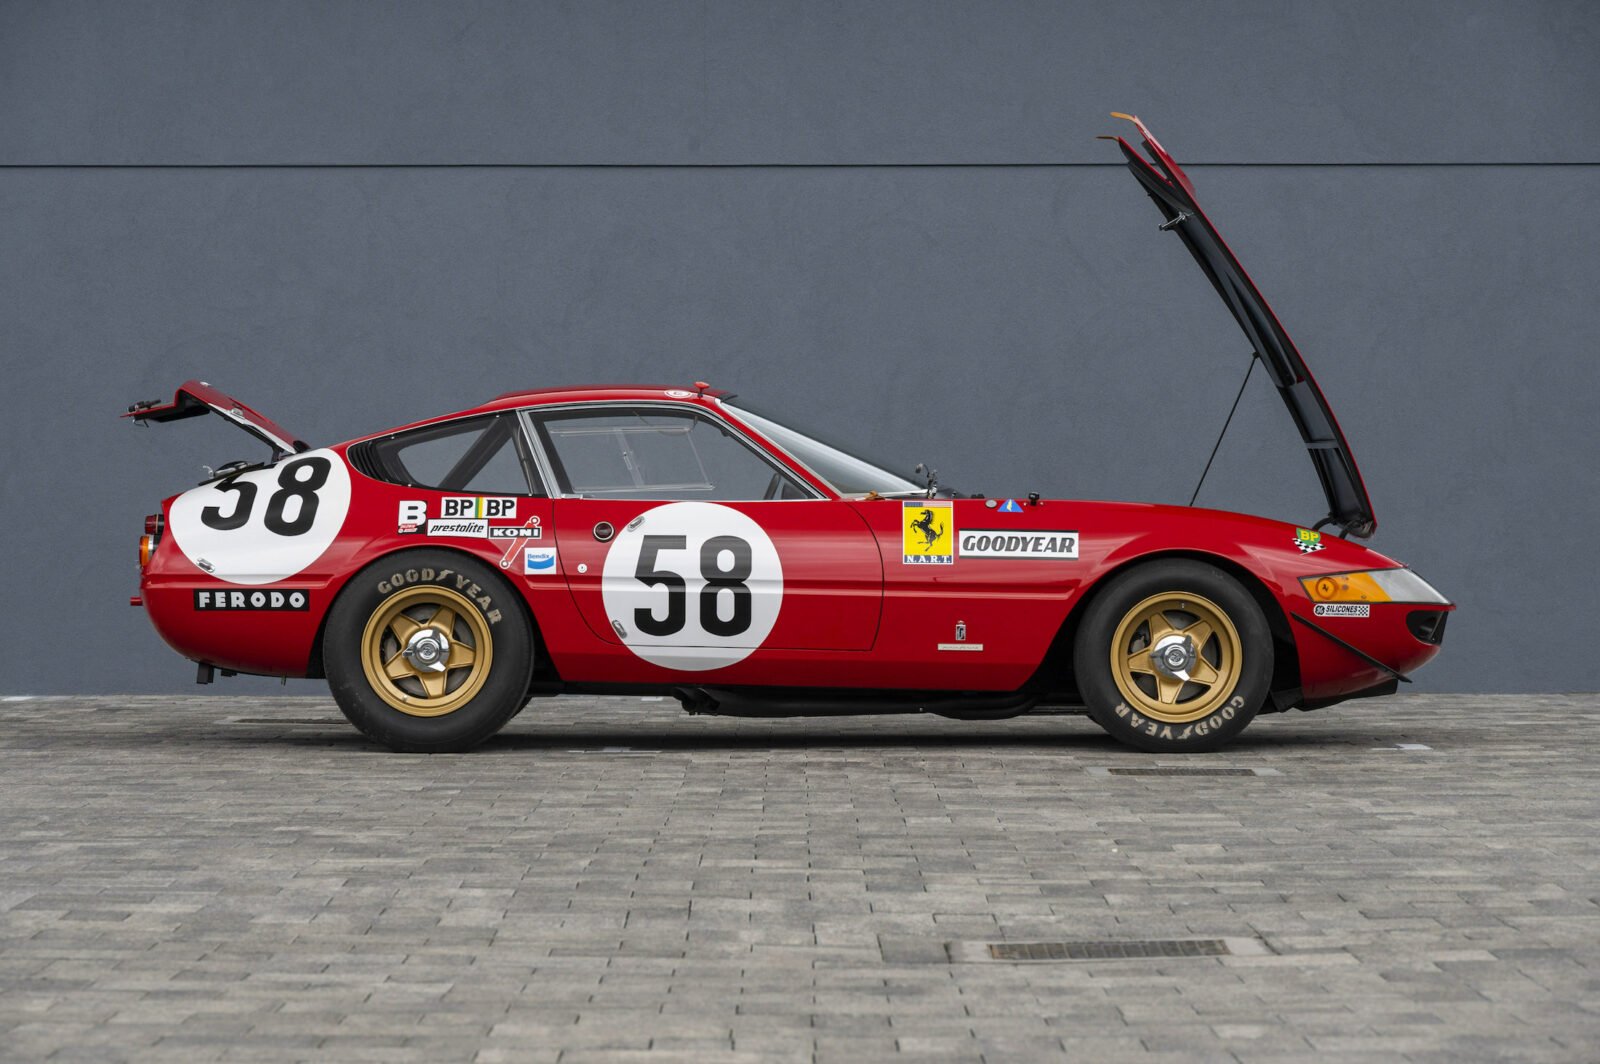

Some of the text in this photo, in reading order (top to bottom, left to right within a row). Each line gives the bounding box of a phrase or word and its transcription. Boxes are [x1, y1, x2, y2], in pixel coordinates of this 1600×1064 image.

[201, 456, 332, 537] 58
[444, 499, 515, 516] BP BP
[430, 522, 485, 534] prestolite
[493, 528, 539, 537] KONI
[1300, 529, 1319, 541] BP
[962, 535, 1075, 553] GOODYEAR
[906, 555, 950, 563] N.A.R.T.
[634, 534, 753, 637] 58
[198, 591, 306, 608] FERODO
[1326, 605, 1358, 613] SILICONES
